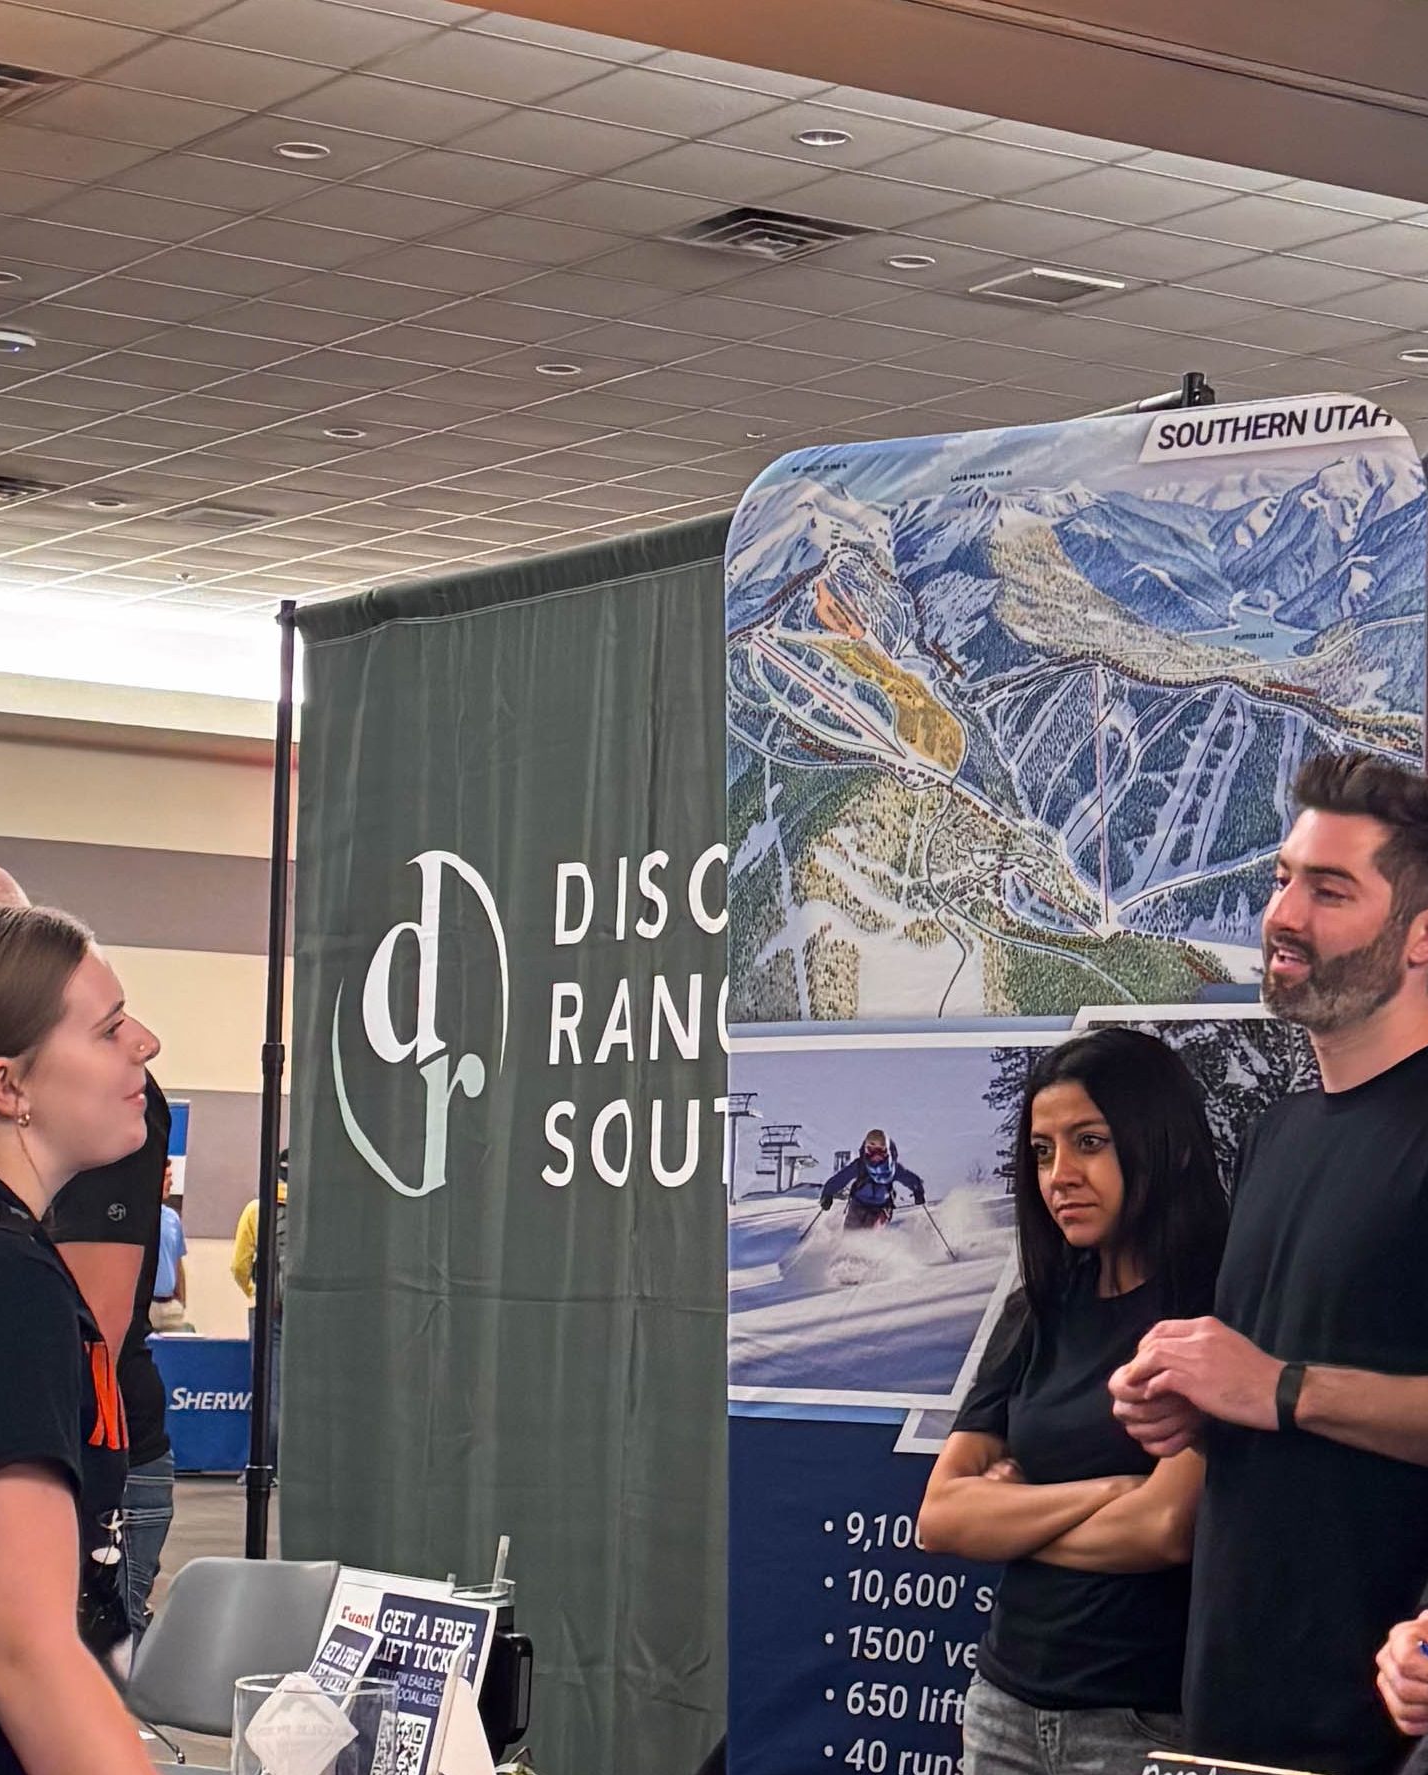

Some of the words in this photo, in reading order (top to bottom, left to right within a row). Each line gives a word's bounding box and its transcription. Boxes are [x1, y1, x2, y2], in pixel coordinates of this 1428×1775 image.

[1158, 409, 1307, 450] SOUTHERN
[548, 973, 728, 1065] RAN
[170, 1386, 252, 1411] SHERW
[847, 1569, 966, 1609] 10,600'
[381, 1609, 416, 1636] GET
[415, 1615, 428, 1639] A
[431, 1617, 476, 1648] FREE
[847, 1625, 935, 1665] 1500'
[374, 1637, 413, 1666] LIFT
[414, 1643, 476, 1677] TICKT
[846, 1681, 908, 1719] 650
[844, 1739, 887, 1774] 40
